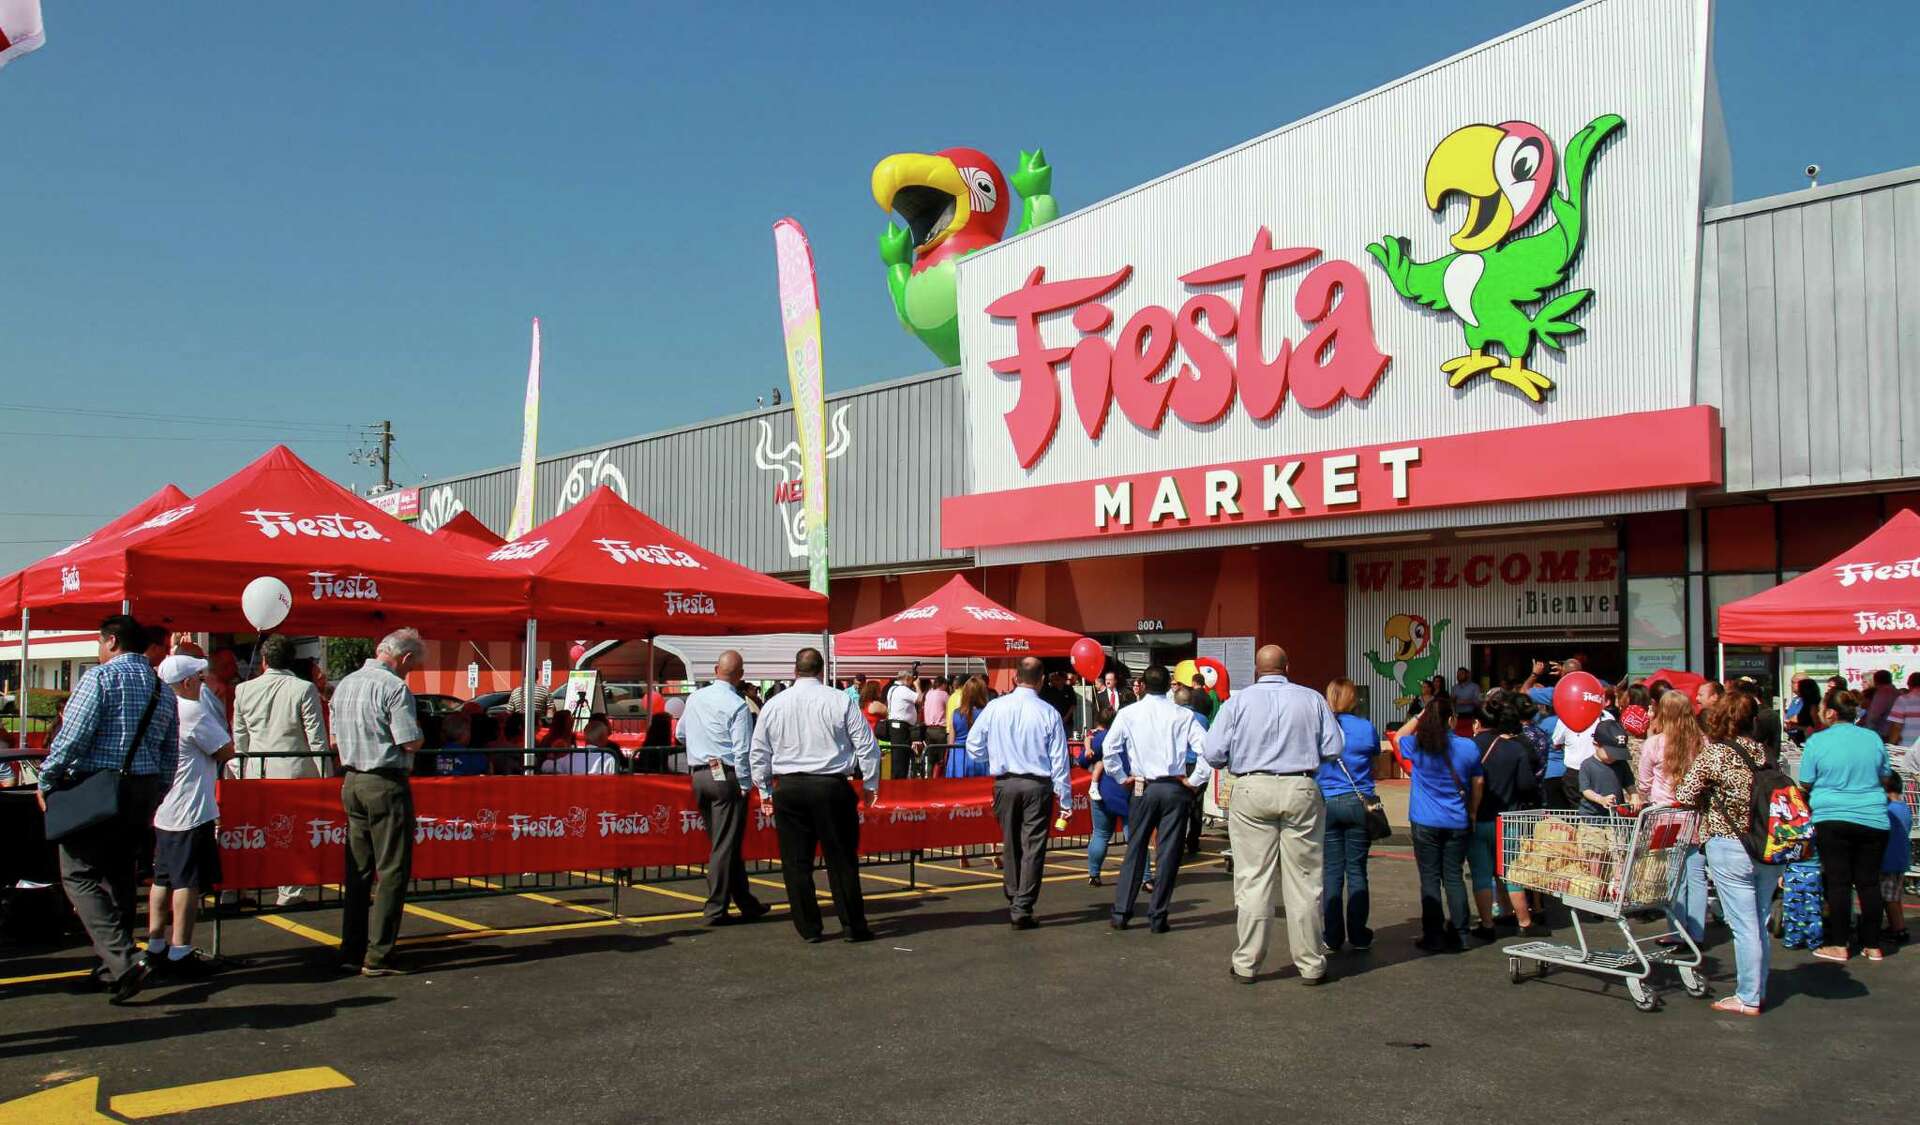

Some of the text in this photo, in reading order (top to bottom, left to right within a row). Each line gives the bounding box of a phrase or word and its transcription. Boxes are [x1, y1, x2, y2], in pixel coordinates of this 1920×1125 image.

[984, 225, 1393, 470] Fiesta
[774, 480, 804, 504] ME
[1094, 446, 1420, 528] MARKET
[240, 508, 384, 540] Fiesta
[486, 538, 550, 562] Fiesta
[592, 537, 701, 569] Fiesta
[1357, 548, 1617, 592] WELCOME
[307, 570, 379, 600] Fiesta
[663, 591, 715, 616] Fiesta
[1517, 591, 1620, 619] ¡Bienve
[1137, 620, 1163, 631] 800 A
[1853, 609, 1917, 635] Fiesta
[217, 823, 266, 850] esta
[415, 815, 474, 844] Fiesta
[508, 811, 565, 841] Fiesta
[596, 809, 650, 838] Fiesta
